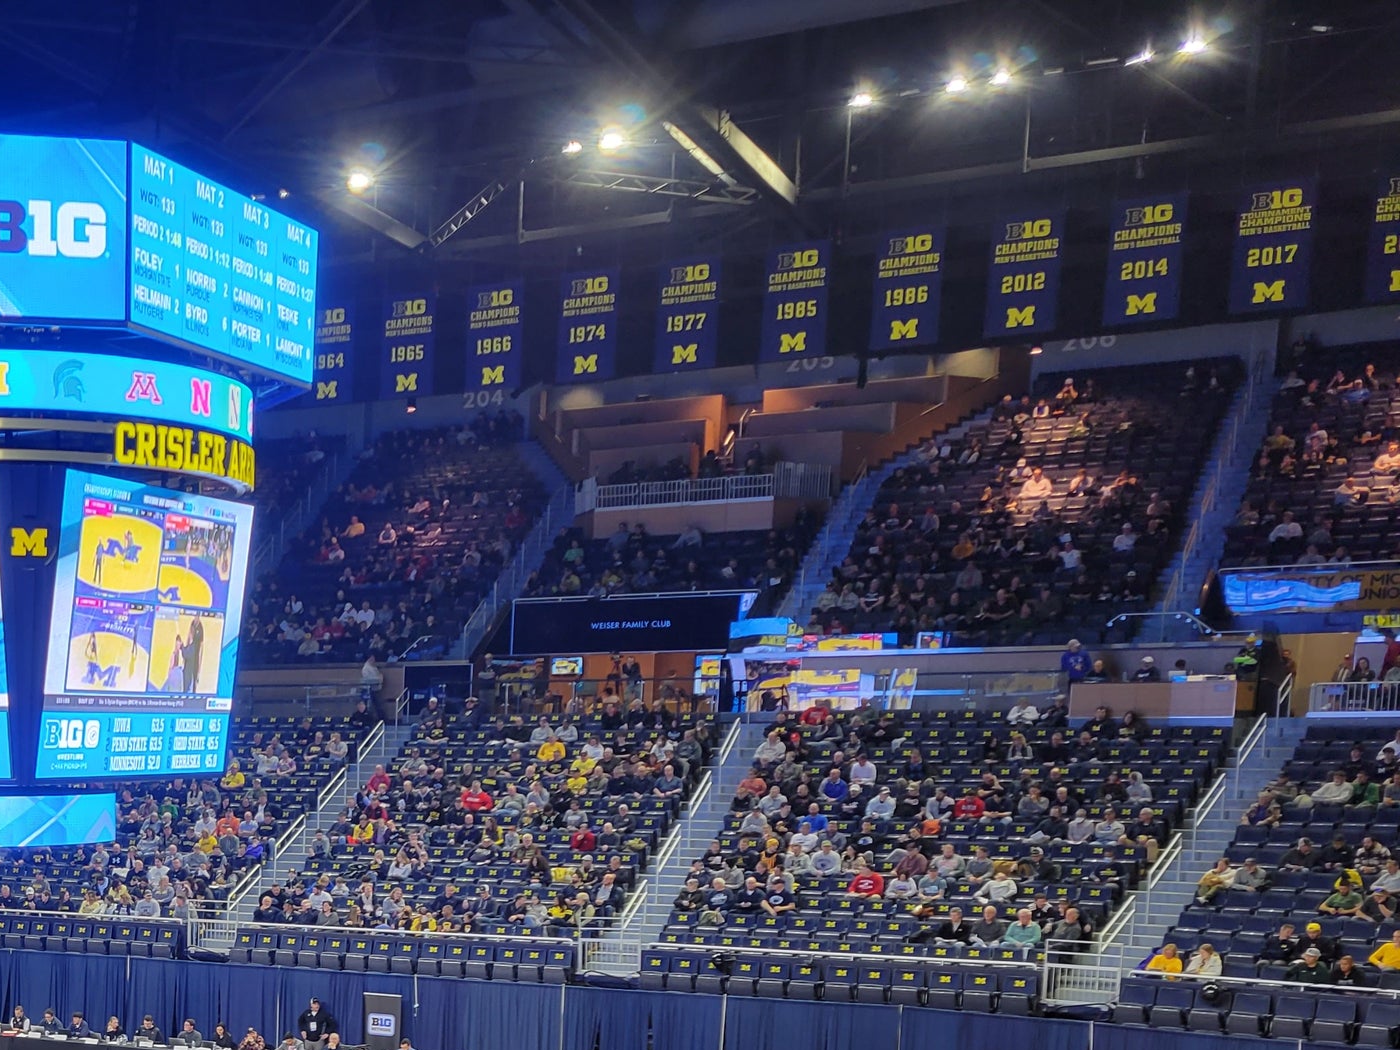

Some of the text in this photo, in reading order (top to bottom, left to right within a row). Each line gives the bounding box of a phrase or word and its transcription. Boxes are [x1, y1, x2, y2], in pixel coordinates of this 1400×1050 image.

[144, 155, 174, 185] MAT 1
[196, 179, 224, 208] MAT 2
[1239, 212, 1311, 229] CHAMPIONS
[1240, 206, 1312, 220] TOURNAMENT
[1114, 224, 1182, 242] CHAMPIONS
[995, 238, 1059, 256] CHAMPIONS
[1247, 244, 1298, 268] 2017
[135, 247, 163, 271] FOLEY
[879, 253, 940, 271] CHAMPIONS
[768, 267, 826, 285] CHAMPIONS
[1120, 258, 1168, 281] 2014
[662, 282, 717, 298] CHAMPIONS
[1001, 272, 1046, 294] 2012
[1252, 280, 1286, 304] M
[563, 294, 615, 309] CHAMPIONS
[884, 286, 929, 307] 1986
[1125, 292, 1157, 316] M
[185, 303, 207, 324] BYRD
[470, 306, 520, 322] CHAMPIONS
[777, 301, 817, 320] 1985
[1006, 306, 1036, 328] M
[385, 316, 433, 330] CHAMPIONS
[667, 313, 707, 333] 1977
[569, 324, 606, 344] 1974
[780, 332, 807, 353] M
[391, 345, 424, 363] 1965
[476, 336, 512, 355] 1966
[672, 344, 698, 364] M
[191, 377, 212, 417] N
[115, 421, 228, 476] CRISLER
[10, 528, 48, 557] M
[591, 620, 671, 630] WEISER FAMILY CLUB
